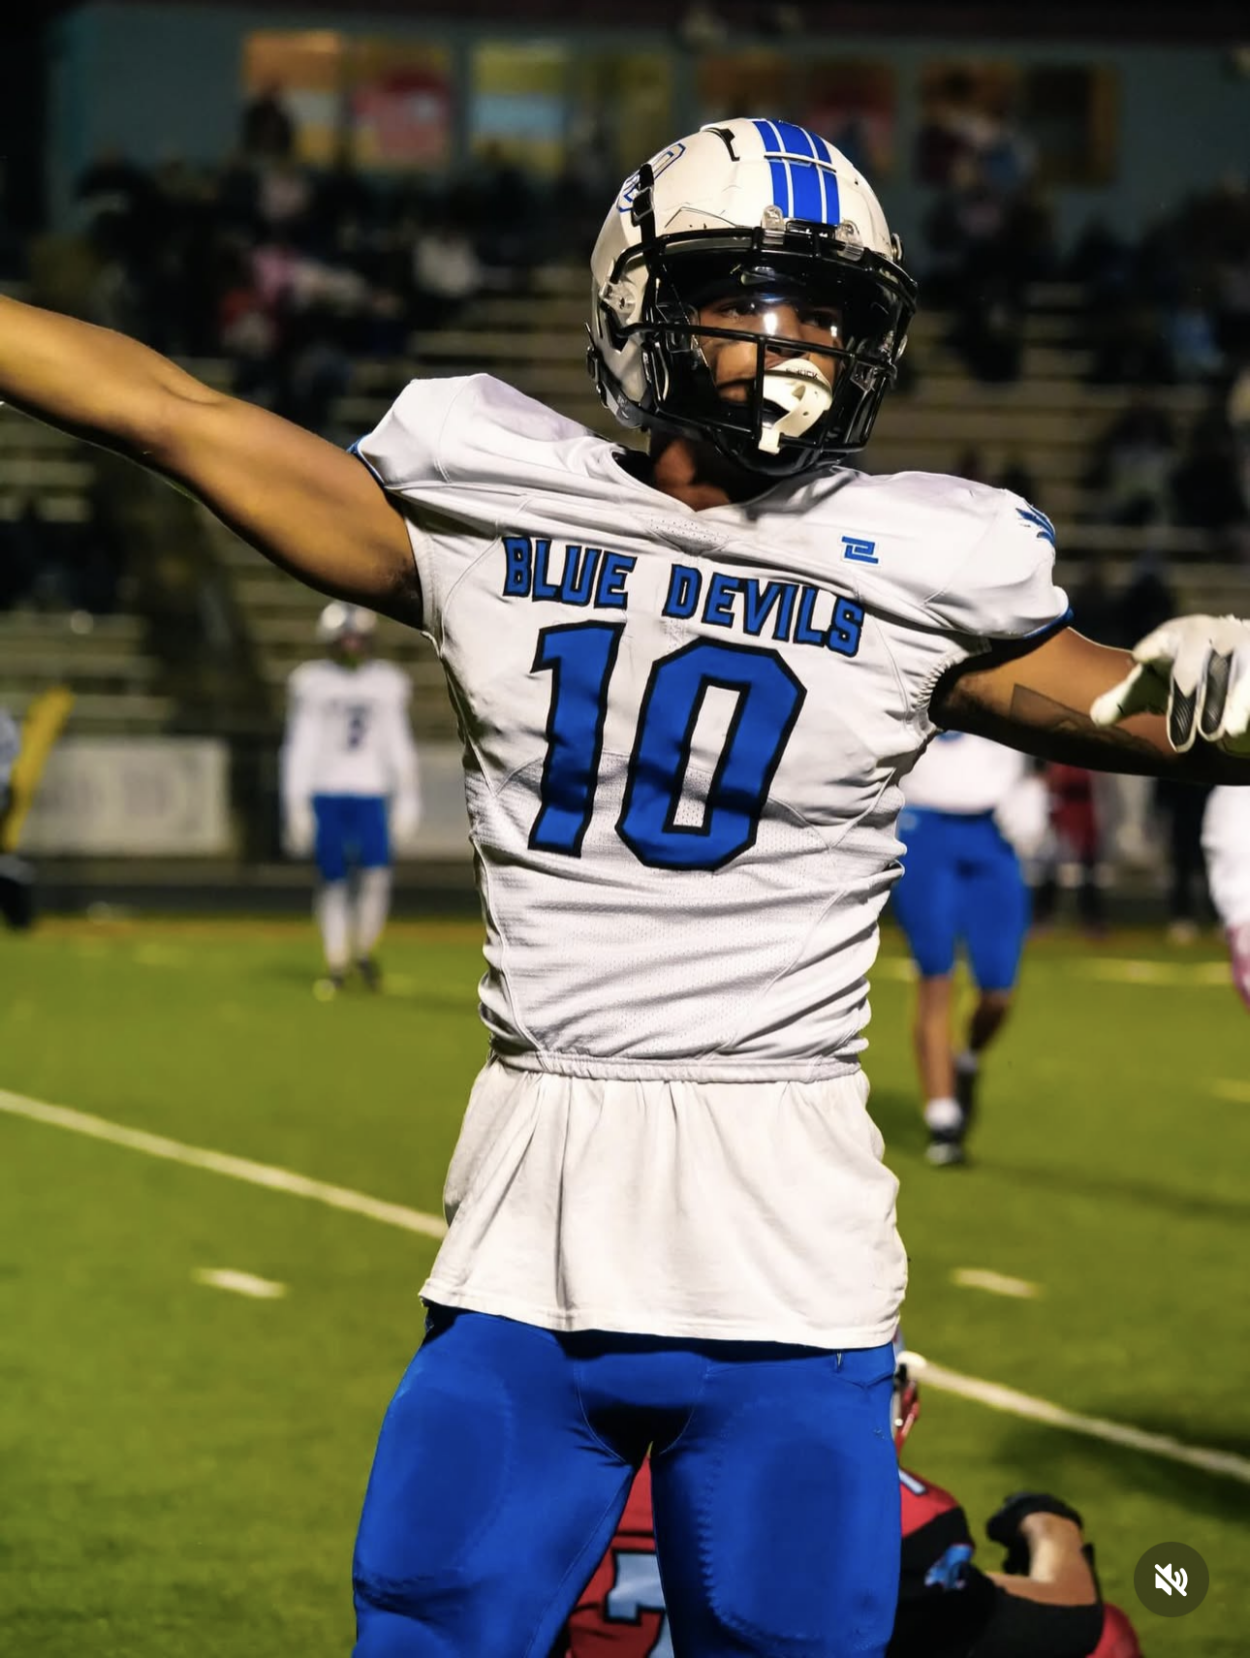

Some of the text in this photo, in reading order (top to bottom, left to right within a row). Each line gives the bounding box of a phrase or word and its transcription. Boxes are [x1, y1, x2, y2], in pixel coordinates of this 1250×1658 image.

[502, 536, 864, 657] BLUE DEVILS
[527, 619, 807, 871] 10
